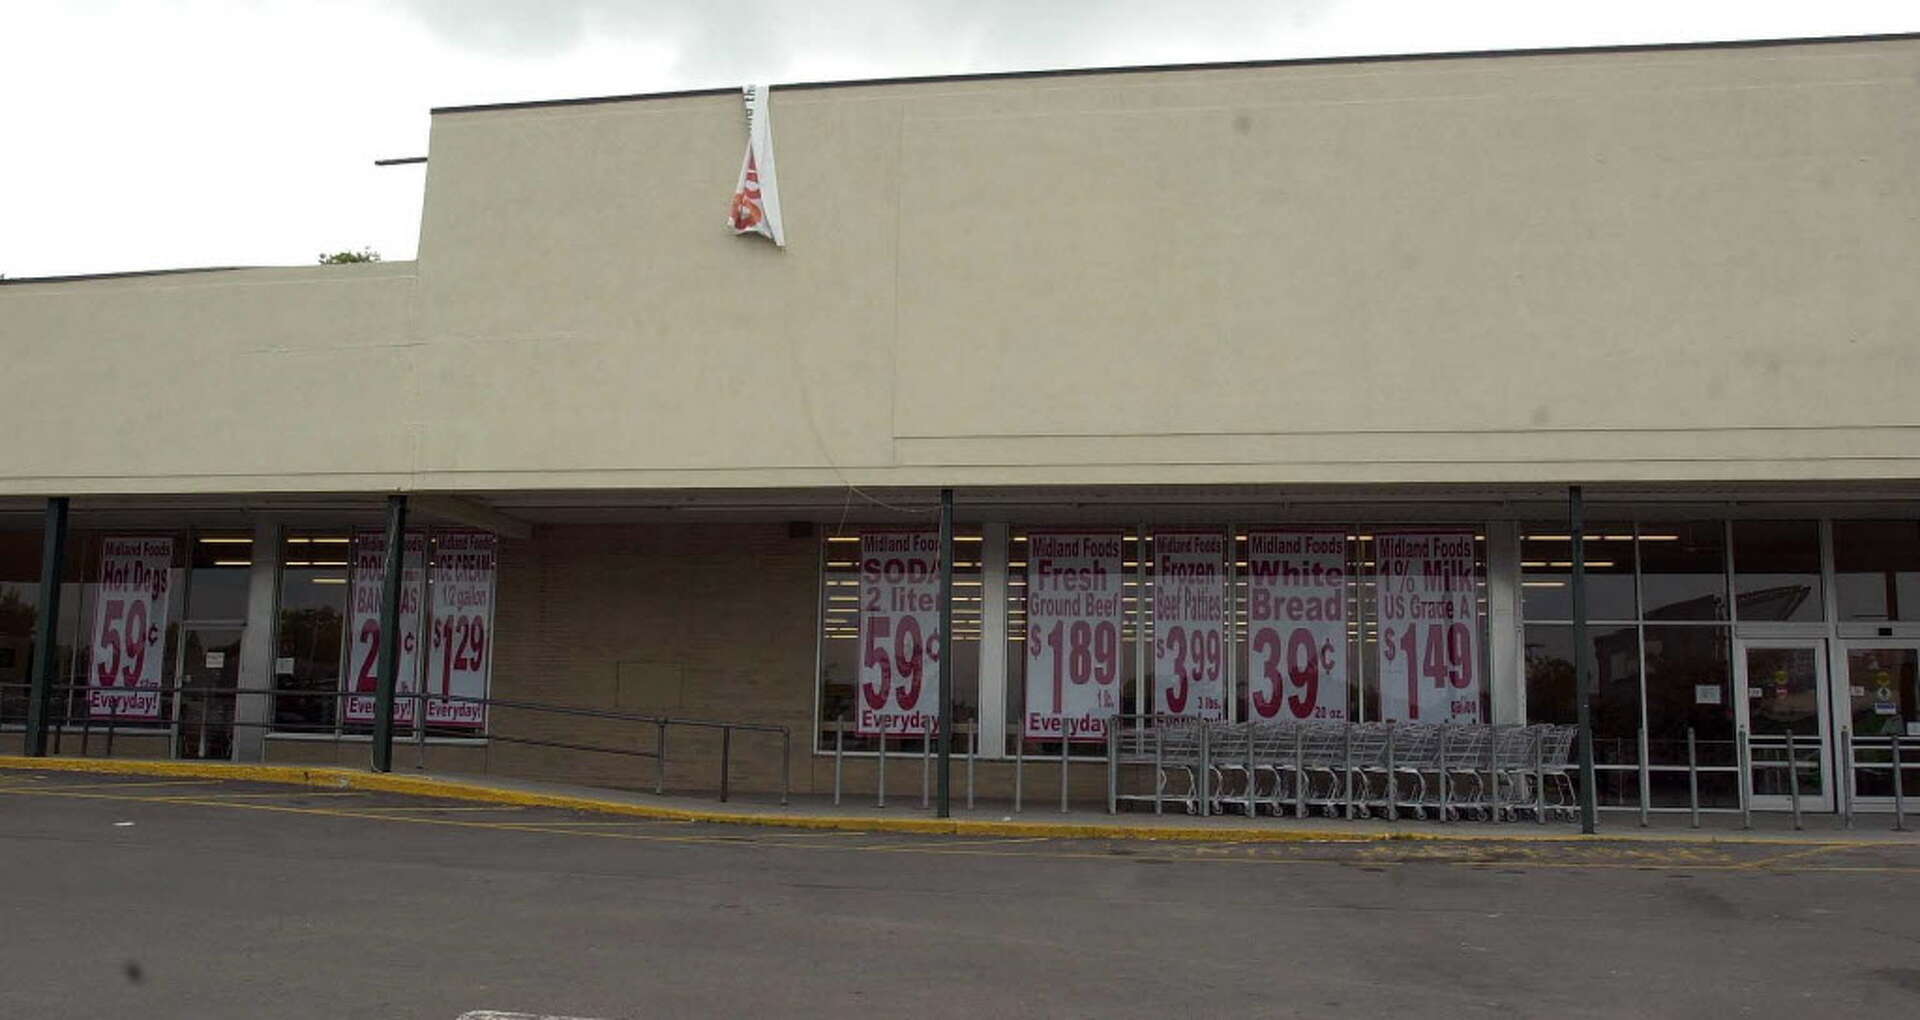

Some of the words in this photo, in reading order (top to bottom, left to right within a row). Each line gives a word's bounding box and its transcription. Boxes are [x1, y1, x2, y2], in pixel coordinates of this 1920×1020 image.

[864, 536, 909, 553] Midland
[1032, 537, 1079, 558] Midland
[1083, 537, 1119, 558] Foods
[1157, 536, 1192, 553] Midland
[1194, 536, 1221, 553] Foods
[1252, 536, 1299, 554] Midland
[1306, 536, 1343, 554] Foods
[1379, 537, 1429, 558] Midland
[1434, 536, 1471, 557] Foods
[103, 560, 129, 592] Hot
[133, 560, 168, 599] Dogs
[360, 554, 385, 581] DOL
[1038, 560, 1107, 591] Fresh
[1162, 556, 1215, 584] Frozen
[1252, 560, 1343, 587] White
[1423, 560, 1472, 592] Milk
[358, 586, 417, 613] BANAS
[866, 587, 881, 612] 2
[1030, 593, 1080, 617] Ground
[1085, 592, 1118, 617] Beef
[1157, 587, 1181, 621] Beef
[1252, 589, 1342, 621] Bread
[1385, 595, 1405, 619] US
[1410, 594, 1454, 619] Grade
[1460, 594, 1471, 619] A
[356, 618, 415, 692] 2¢
[92, 691, 157, 713] Everyday!
[350, 698, 412, 718] Everay!
[428, 701, 481, 720] Everyday!
[862, 710, 941, 732] Everyday
[1029, 713, 1108, 736] Everyday
